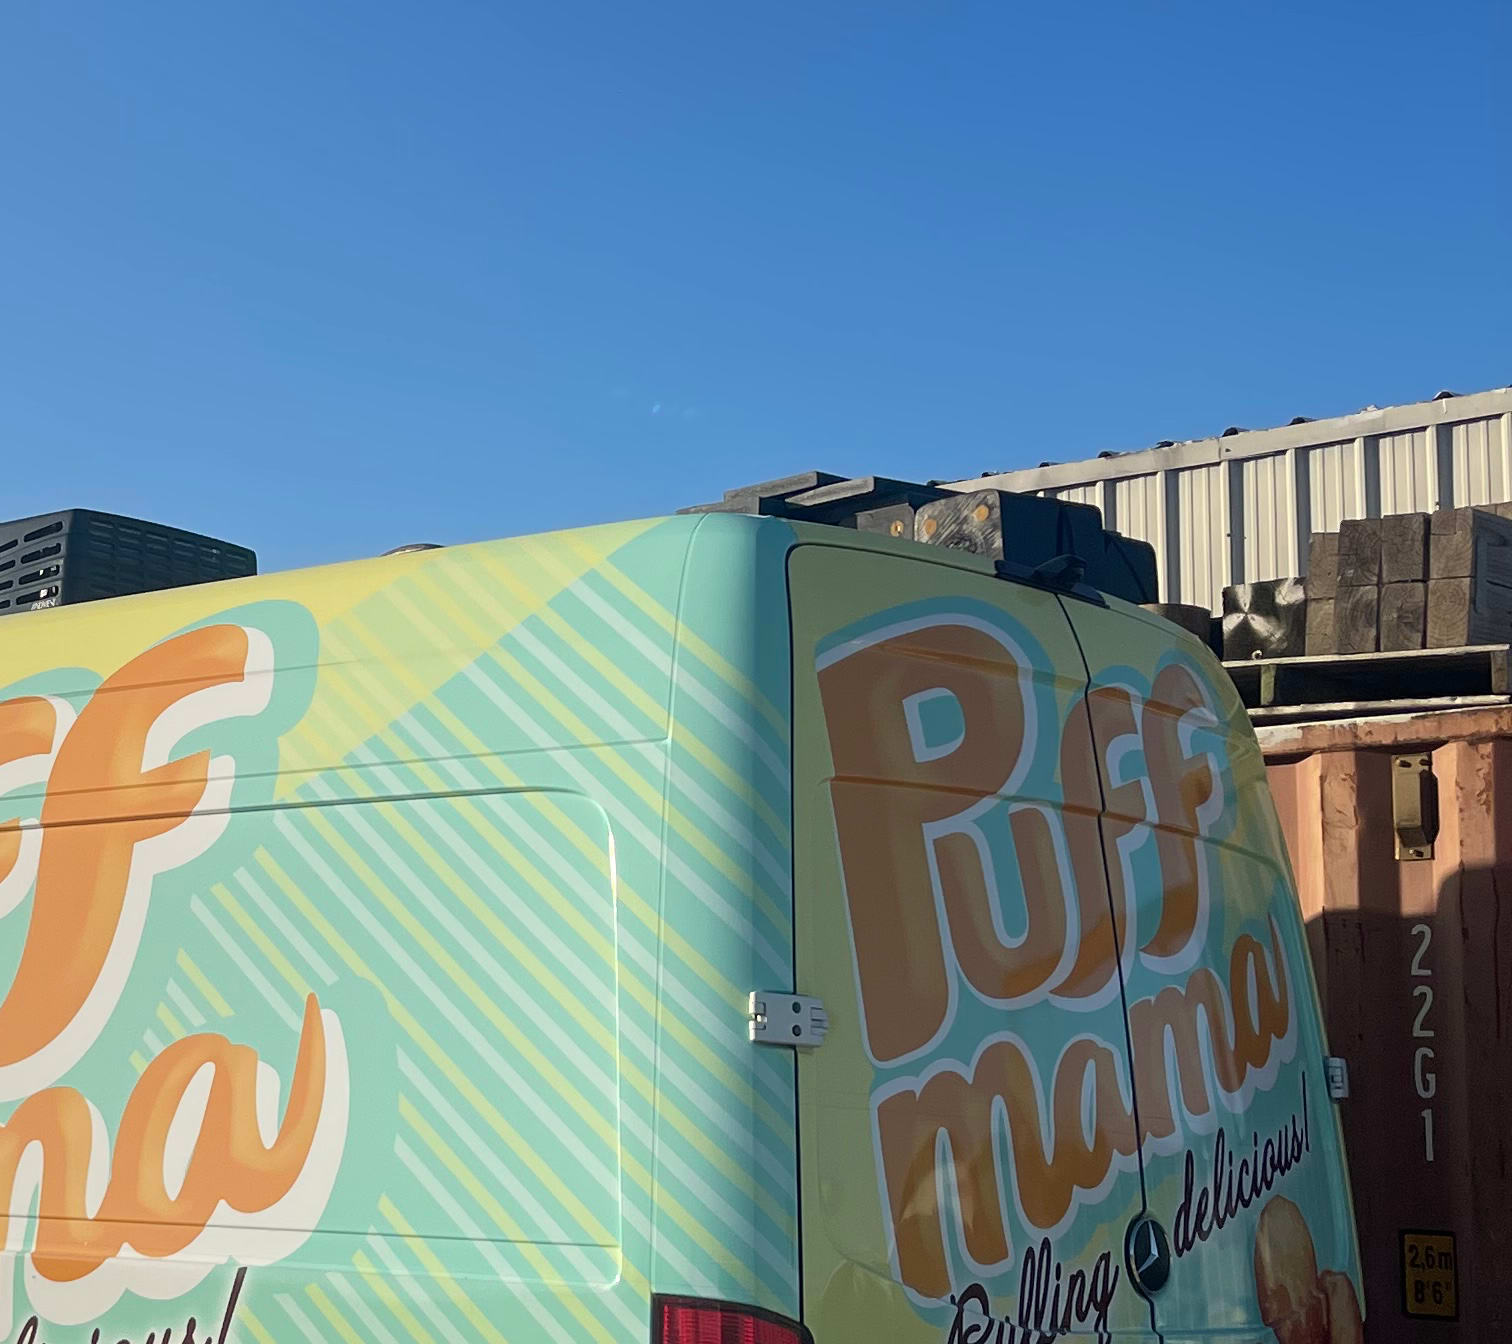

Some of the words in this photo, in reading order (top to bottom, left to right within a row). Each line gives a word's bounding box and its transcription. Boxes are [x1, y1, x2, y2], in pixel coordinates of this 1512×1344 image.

[815, 613, 1220, 1067] Puff
[870, 911, 1296, 1307] mama
[1174, 1070, 1310, 1258] delicious!
